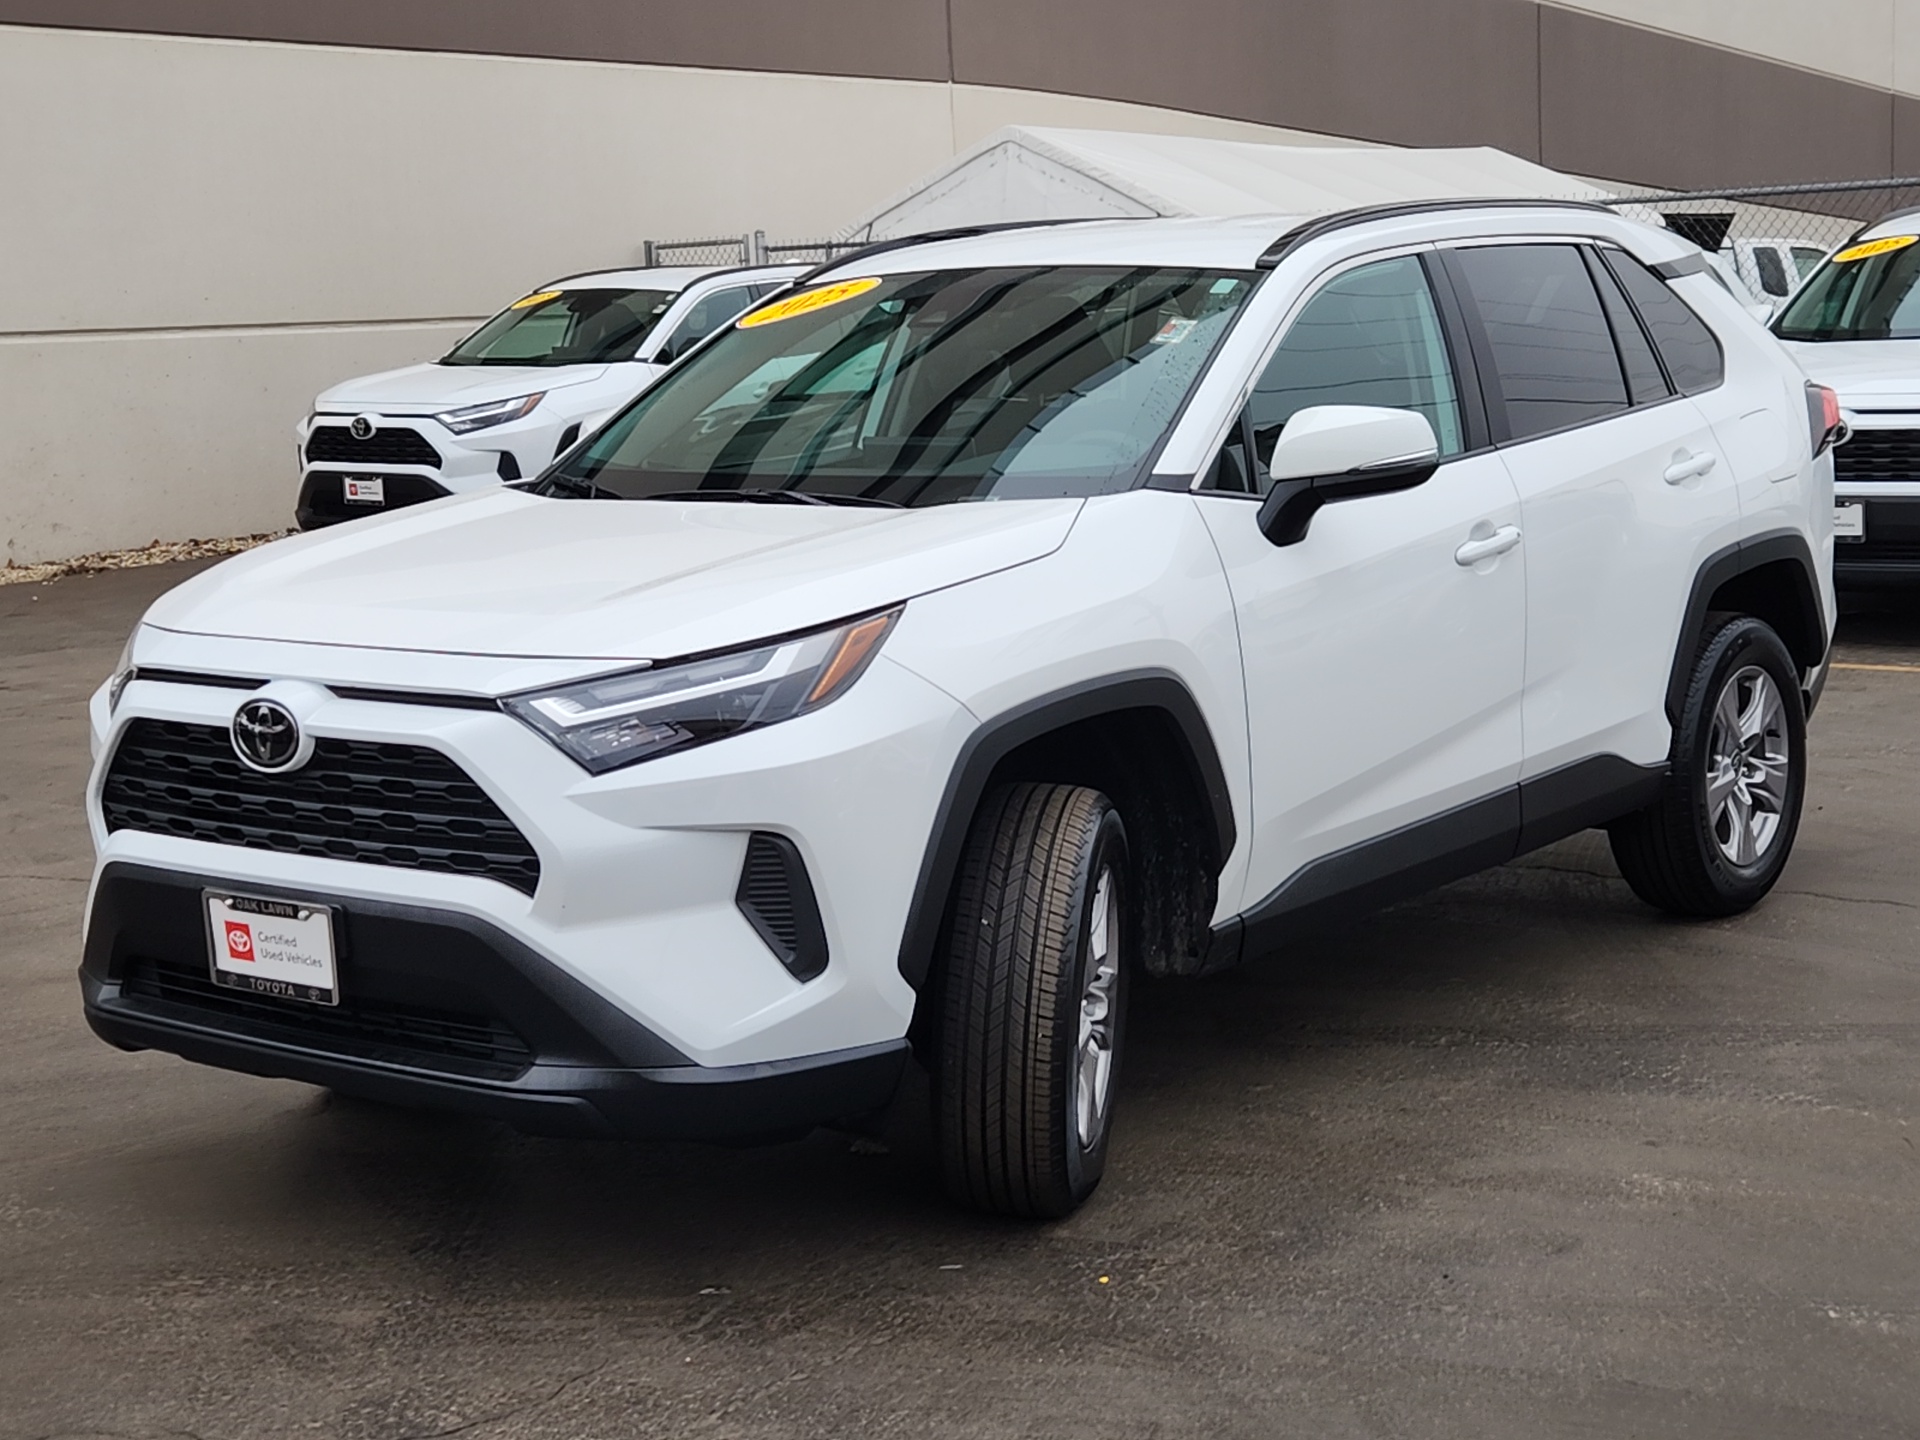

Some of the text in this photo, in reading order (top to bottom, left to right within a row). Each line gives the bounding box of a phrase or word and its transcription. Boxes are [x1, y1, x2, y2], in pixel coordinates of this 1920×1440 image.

[756, 281, 862, 322] 2025
[235, 898, 294, 917] OAK LAWN
[257, 931, 297, 948] Certified
[260, 948, 323, 968] Used Vehicles
[249, 977, 296, 996] TOYOTA
